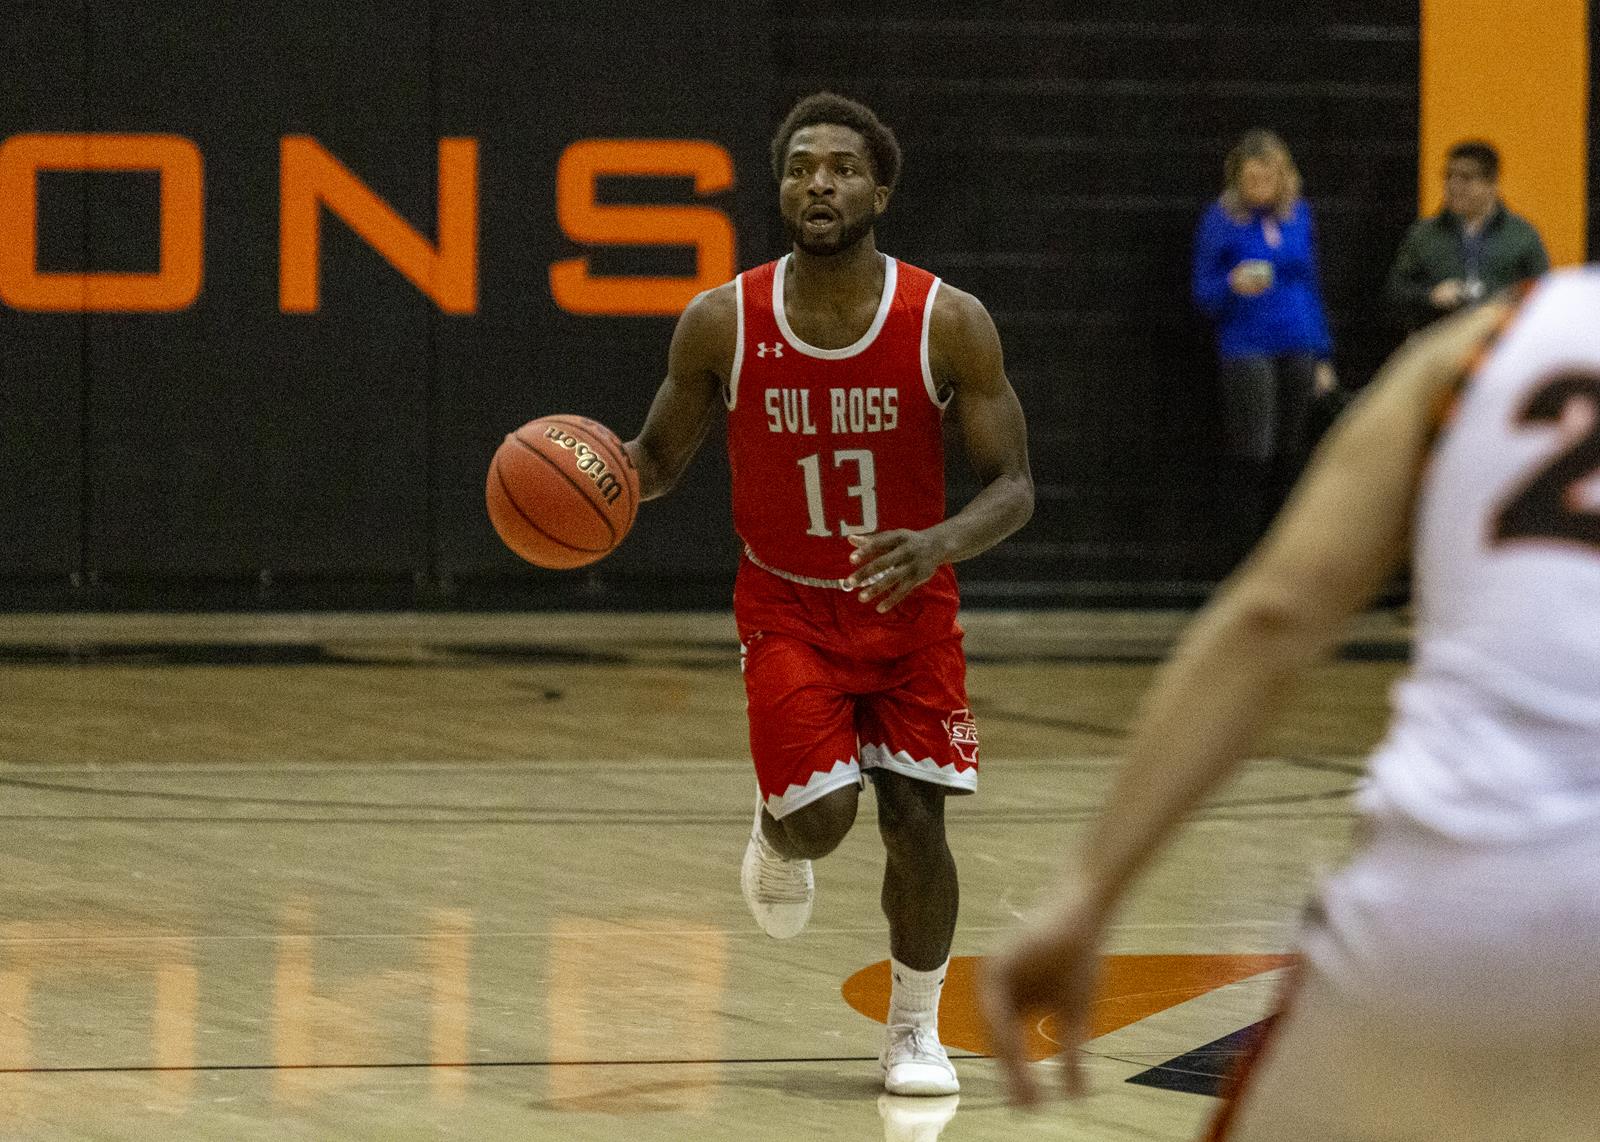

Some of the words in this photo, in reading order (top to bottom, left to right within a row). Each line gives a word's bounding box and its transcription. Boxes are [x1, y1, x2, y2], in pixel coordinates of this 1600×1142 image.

[0, 132, 736, 317] ONS
[764, 387, 818, 435] SUL
[829, 387, 899, 434] ROSS
[543, 426, 623, 507] Wilson
[796, 449, 878, 537] 13
[1484, 364, 1600, 553] 2
